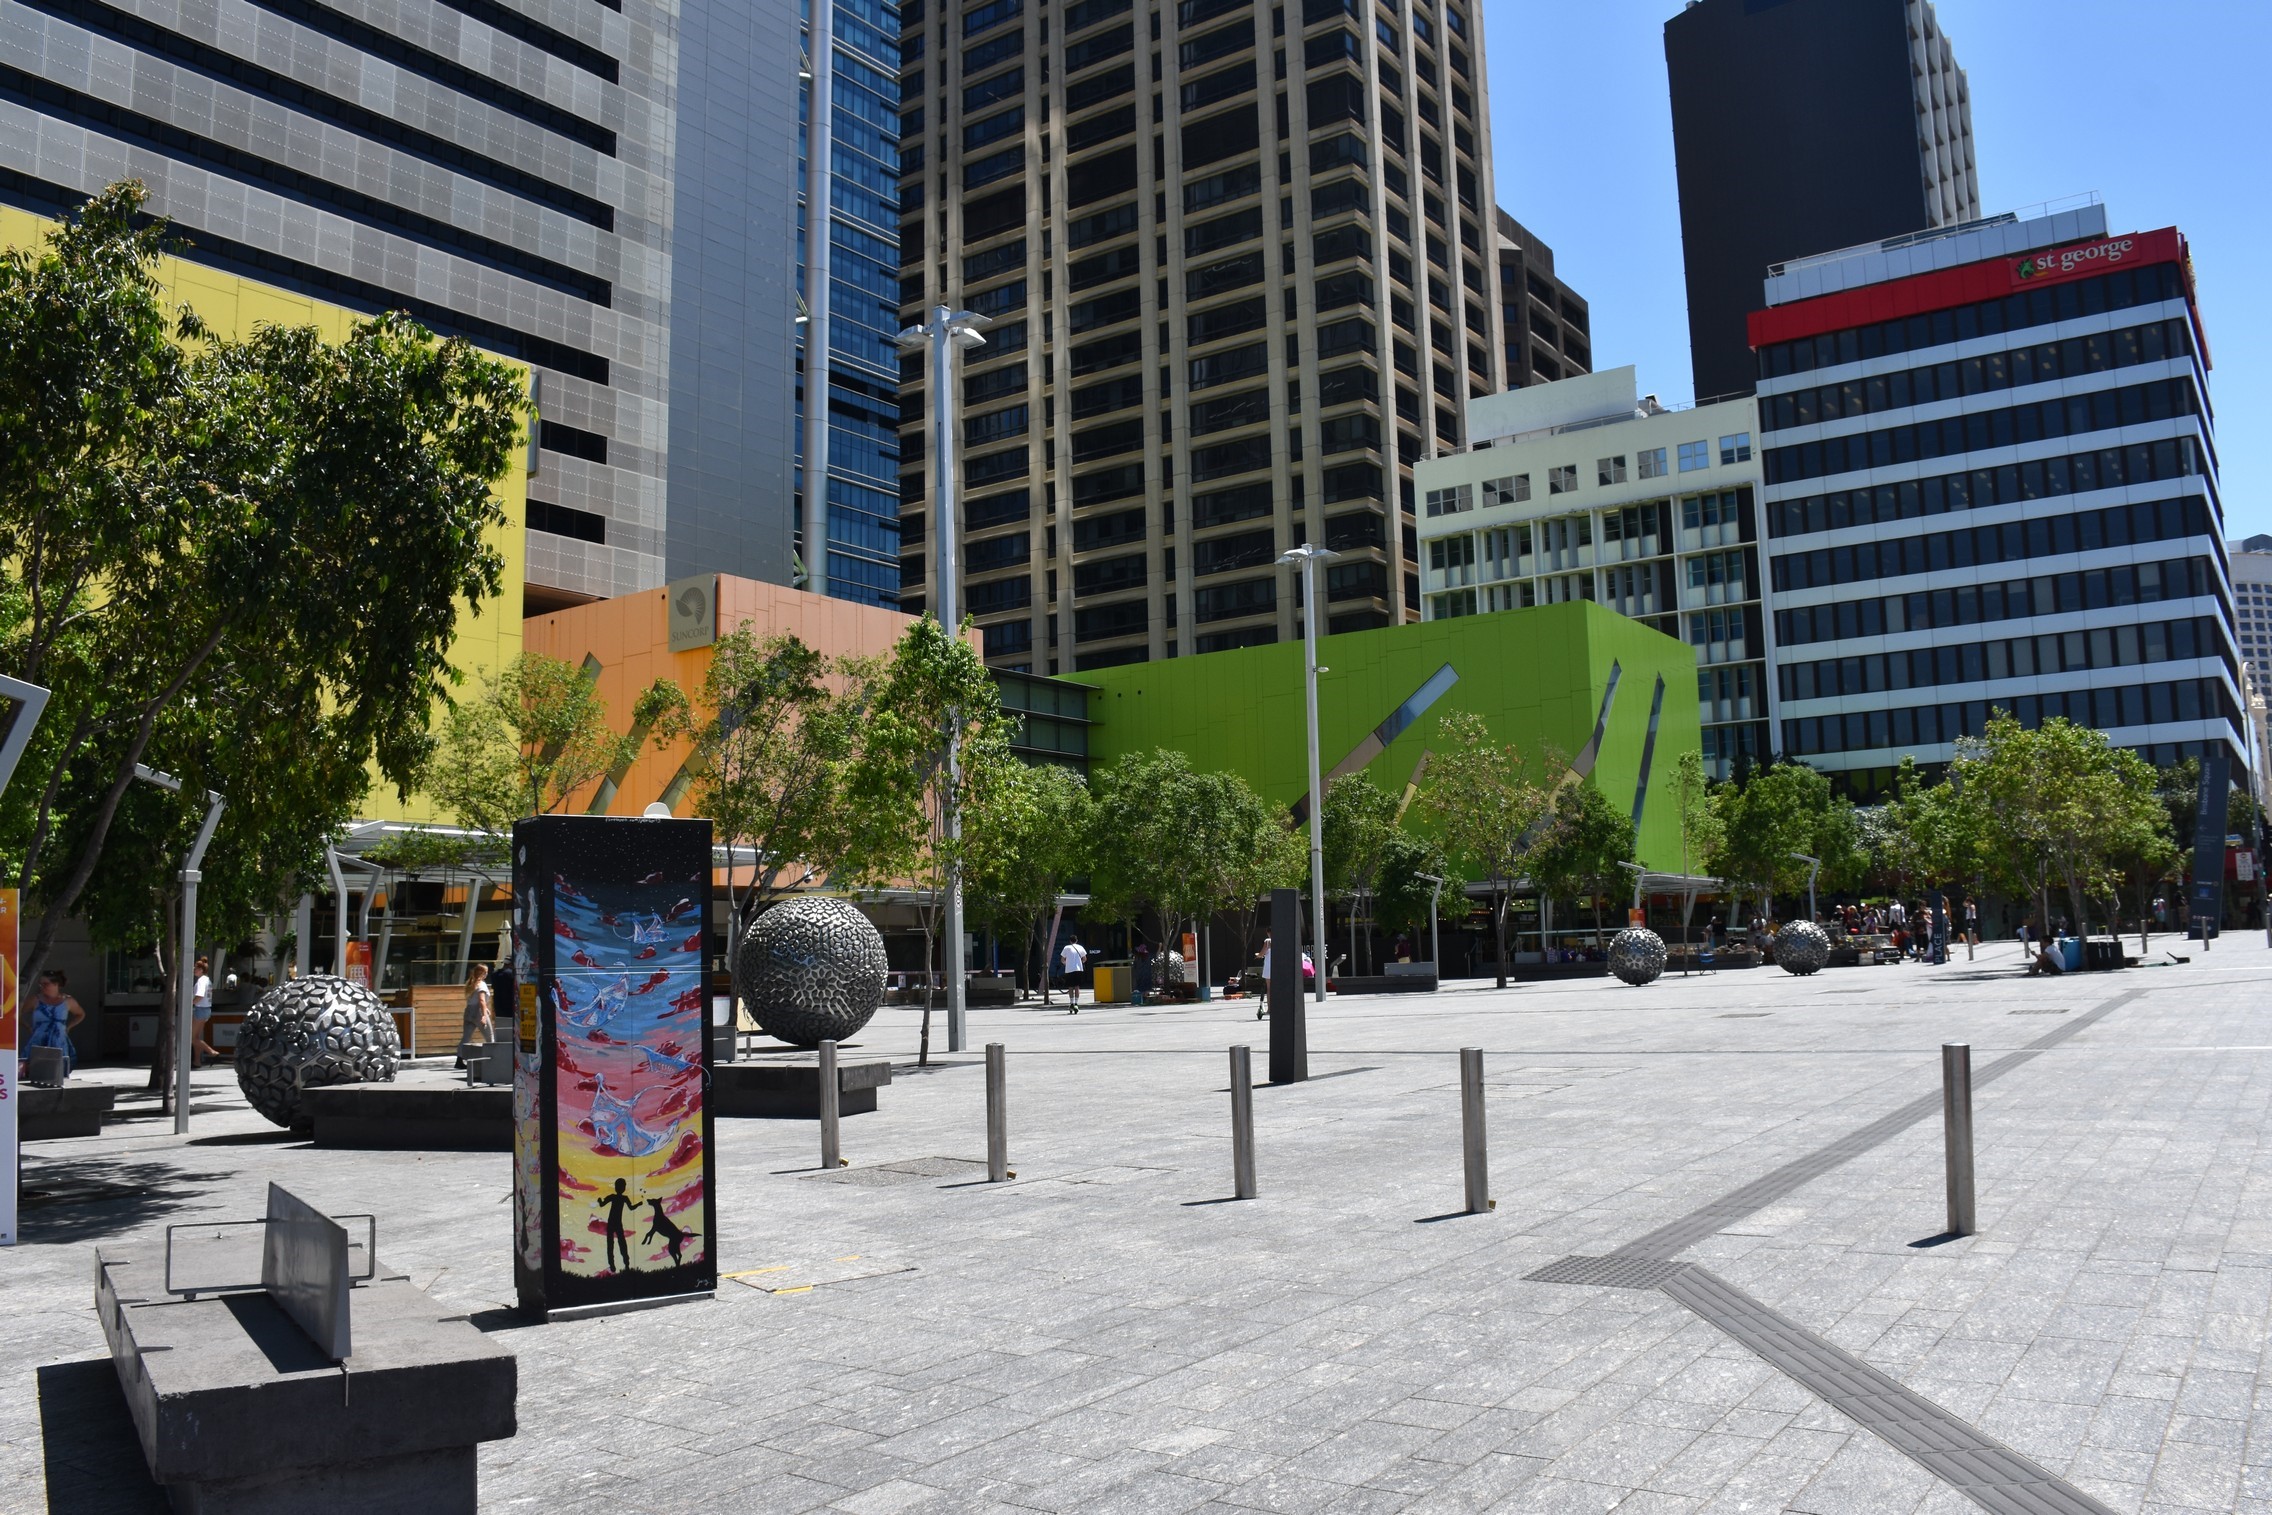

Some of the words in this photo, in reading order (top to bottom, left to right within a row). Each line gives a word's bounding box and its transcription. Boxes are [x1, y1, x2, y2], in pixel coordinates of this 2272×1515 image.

[2061, 239, 2134, 272] george
[672, 626, 710, 642] SUNCORP
[2202, 762, 2211, 785] Square
[2200, 786, 2209, 816] Brisbane
[1933, 933, 1943, 963] PLACE
[350, 966, 366, 978] FEEL
